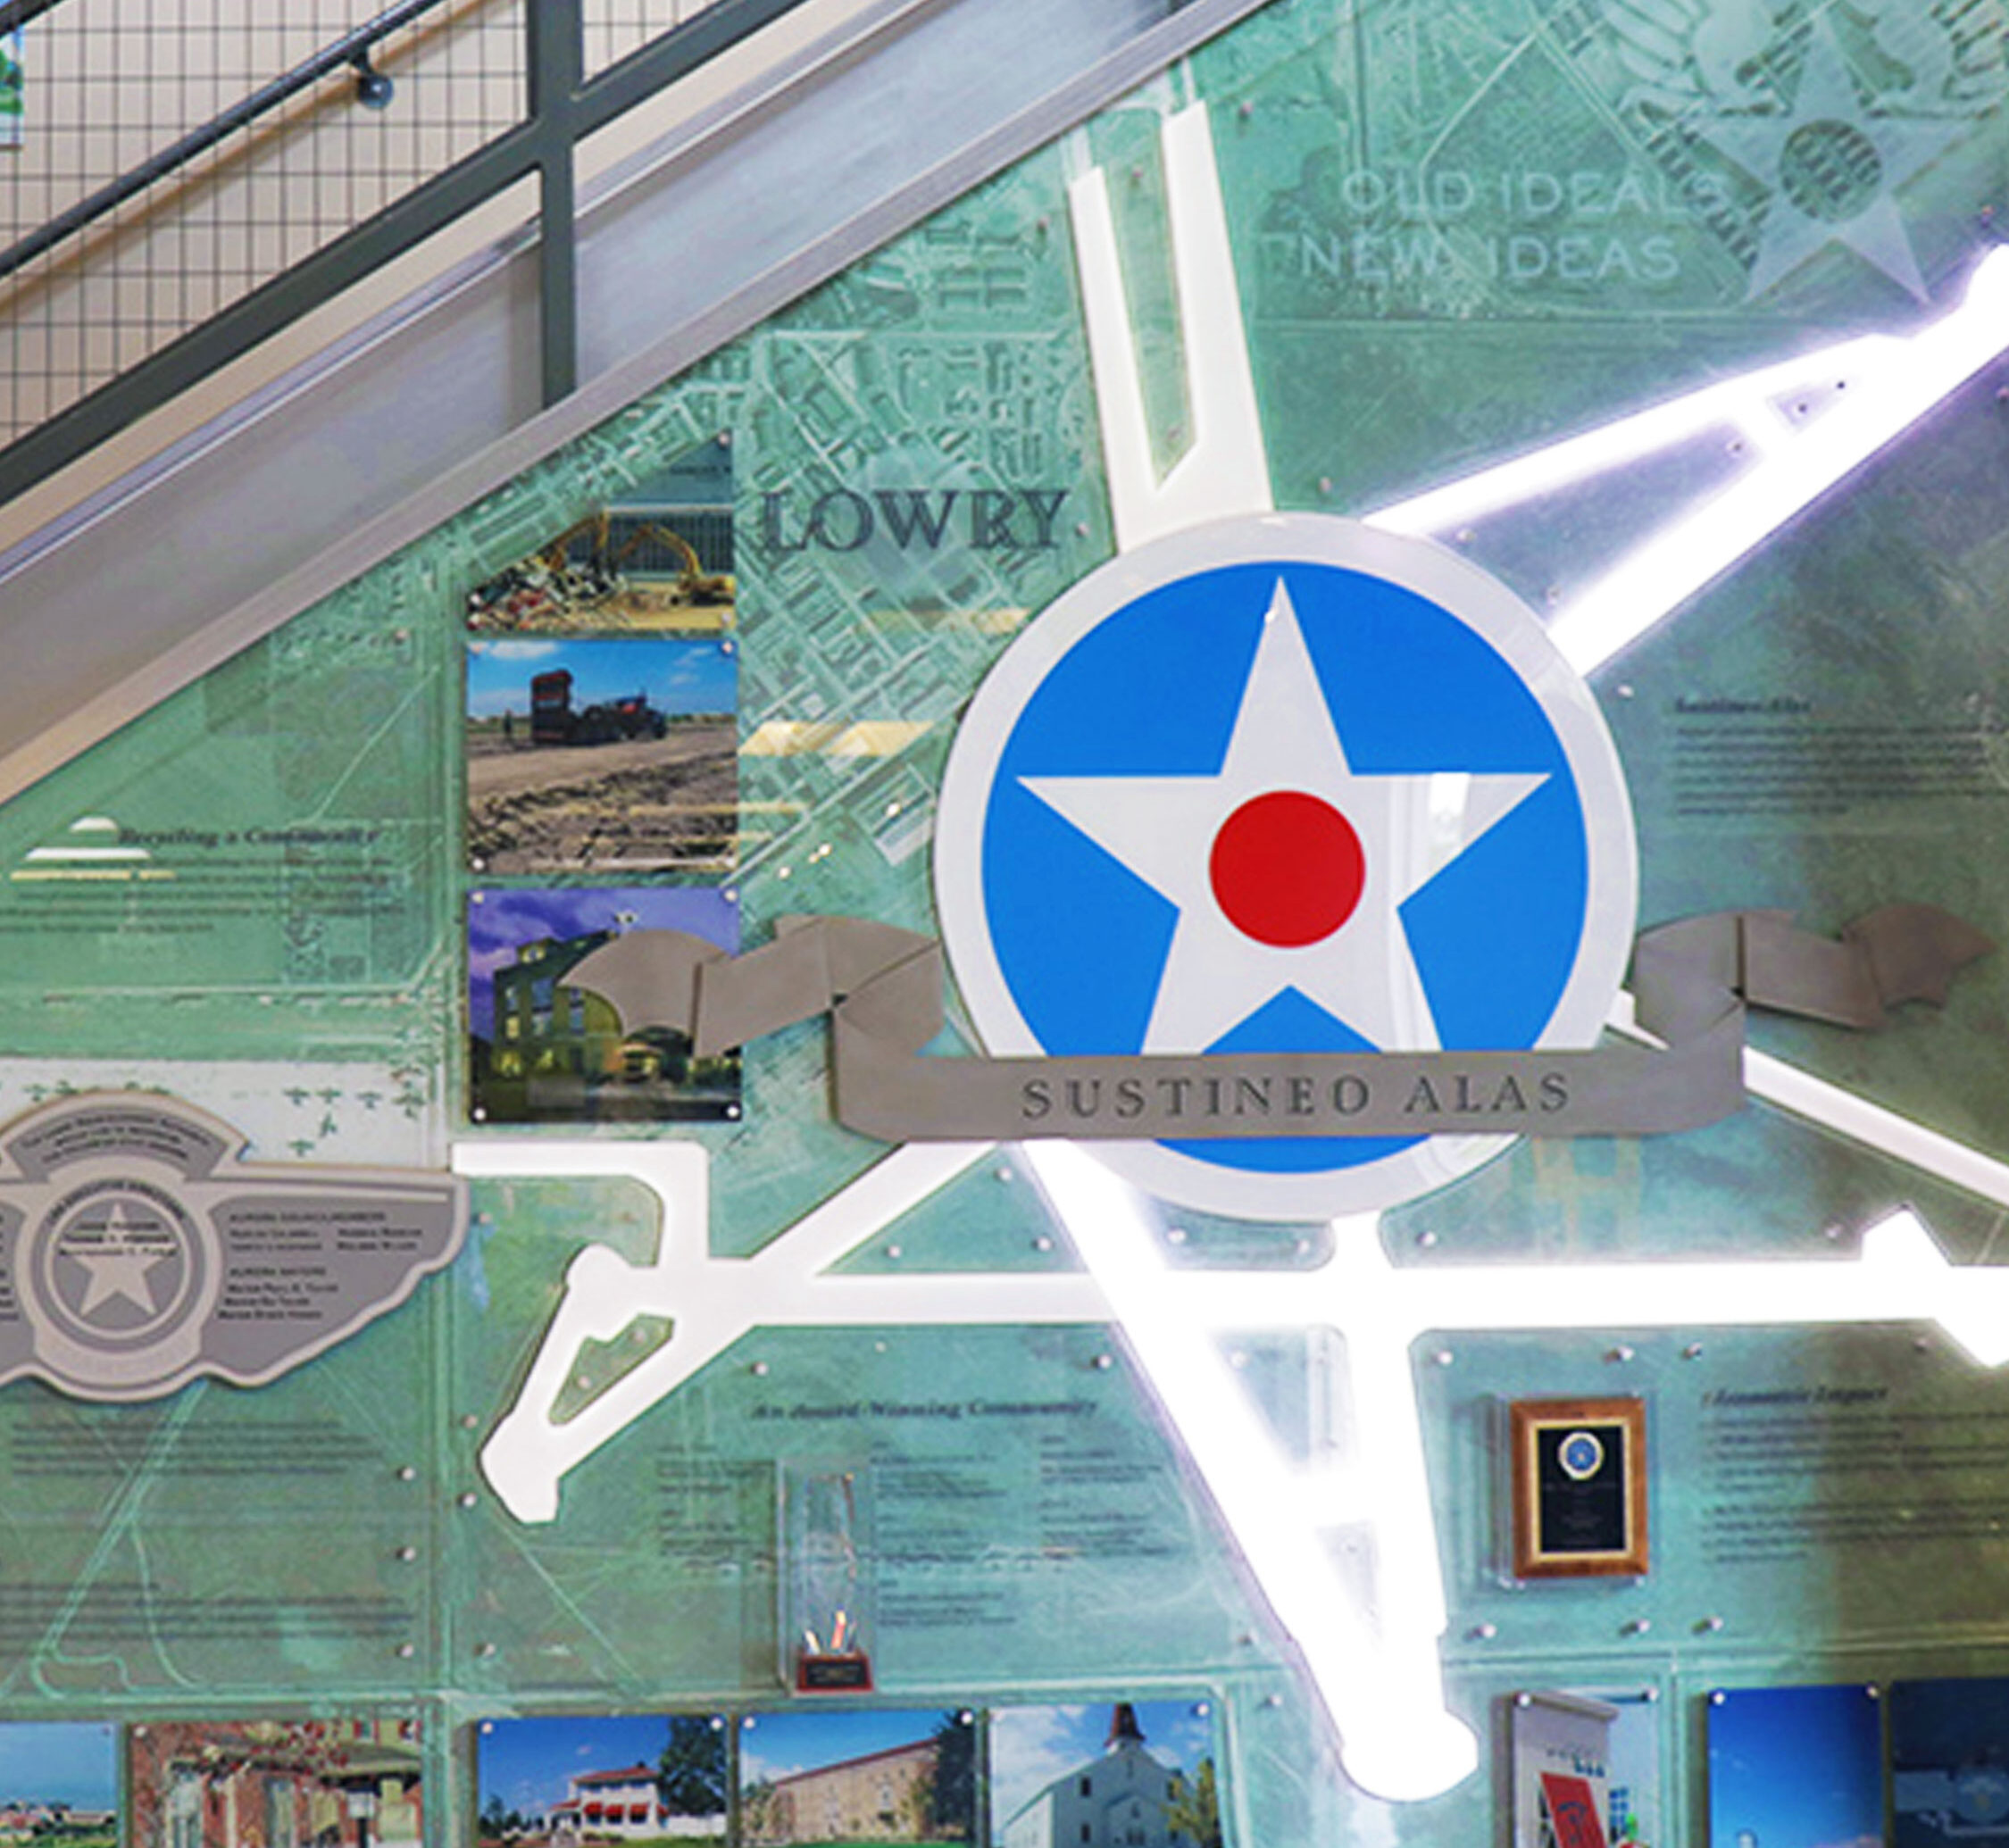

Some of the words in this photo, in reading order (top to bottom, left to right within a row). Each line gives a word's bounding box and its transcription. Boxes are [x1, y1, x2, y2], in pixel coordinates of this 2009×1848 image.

[1342, 170, 1474, 215] OLD
[1300, 233, 1448, 280] NEW
[1488, 234, 1680, 280] IDEAS
[759, 490, 1071, 551] LOWRY
[1021, 1076, 1371, 1119] SUSTINEO
[1404, 1073, 1570, 1114] ALAS
